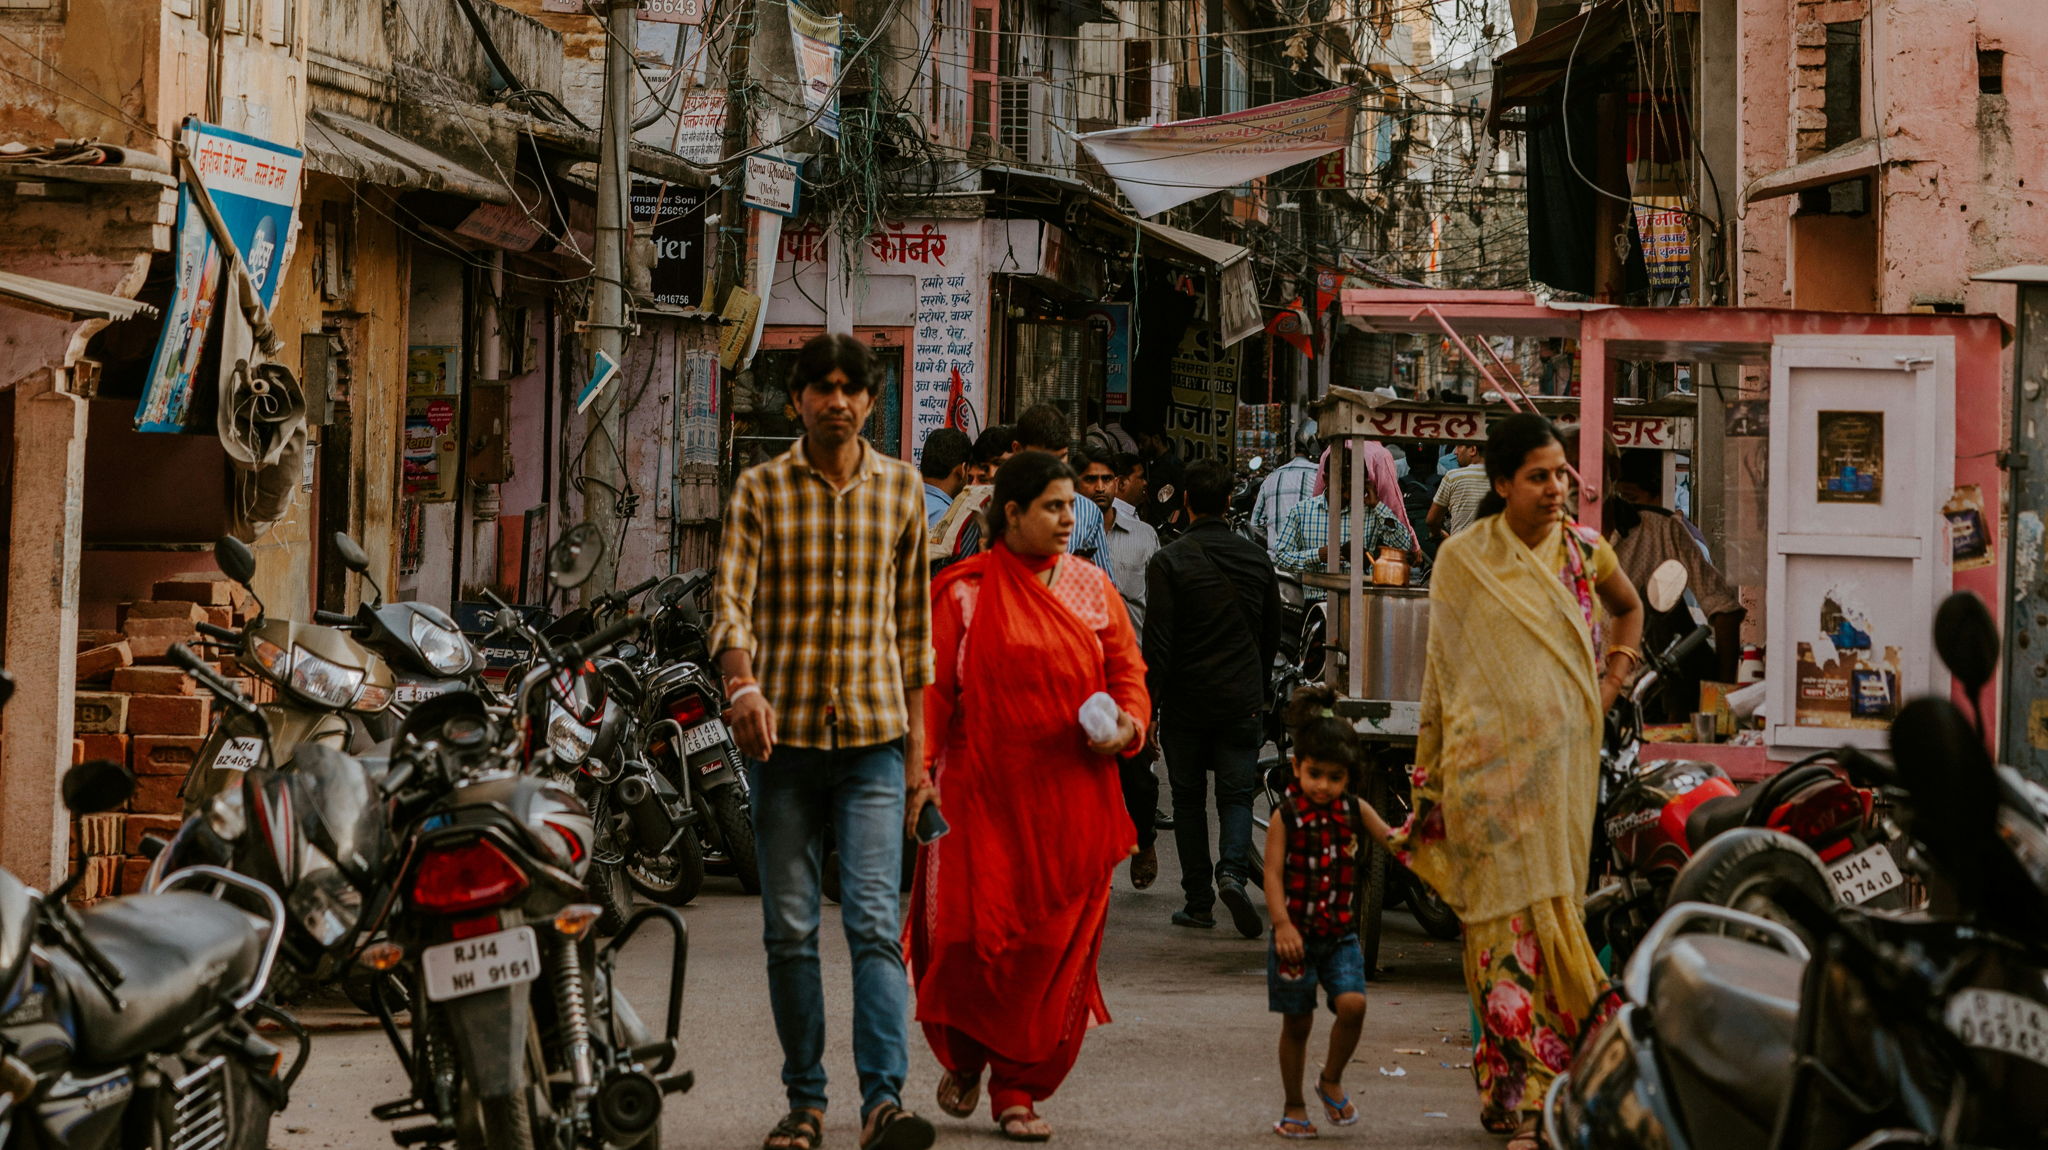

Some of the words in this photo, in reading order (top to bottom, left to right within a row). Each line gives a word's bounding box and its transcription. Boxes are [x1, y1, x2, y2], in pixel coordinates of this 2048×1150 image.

[748, 157, 767, 179] Rama
[674, 196, 697, 204] Soni
[866, 222, 947, 267] कॉर्नर
[921, 274, 944, 291] हमारे
[947, 272, 966, 289] यहां
[950, 310, 973, 322] वायर
[915, 357, 934, 374] धागे
[934, 359, 947, 373] की
[964, 379, 972, 393] के
[1370, 409, 1482, 438] राहुल
[483, 648, 529, 660] PEPSI
[1832, 857, 1871, 884] RJ14
[454, 941, 498, 964] RJ14
[452, 970, 475, 991] NH
[489, 959, 530, 983] 9161
